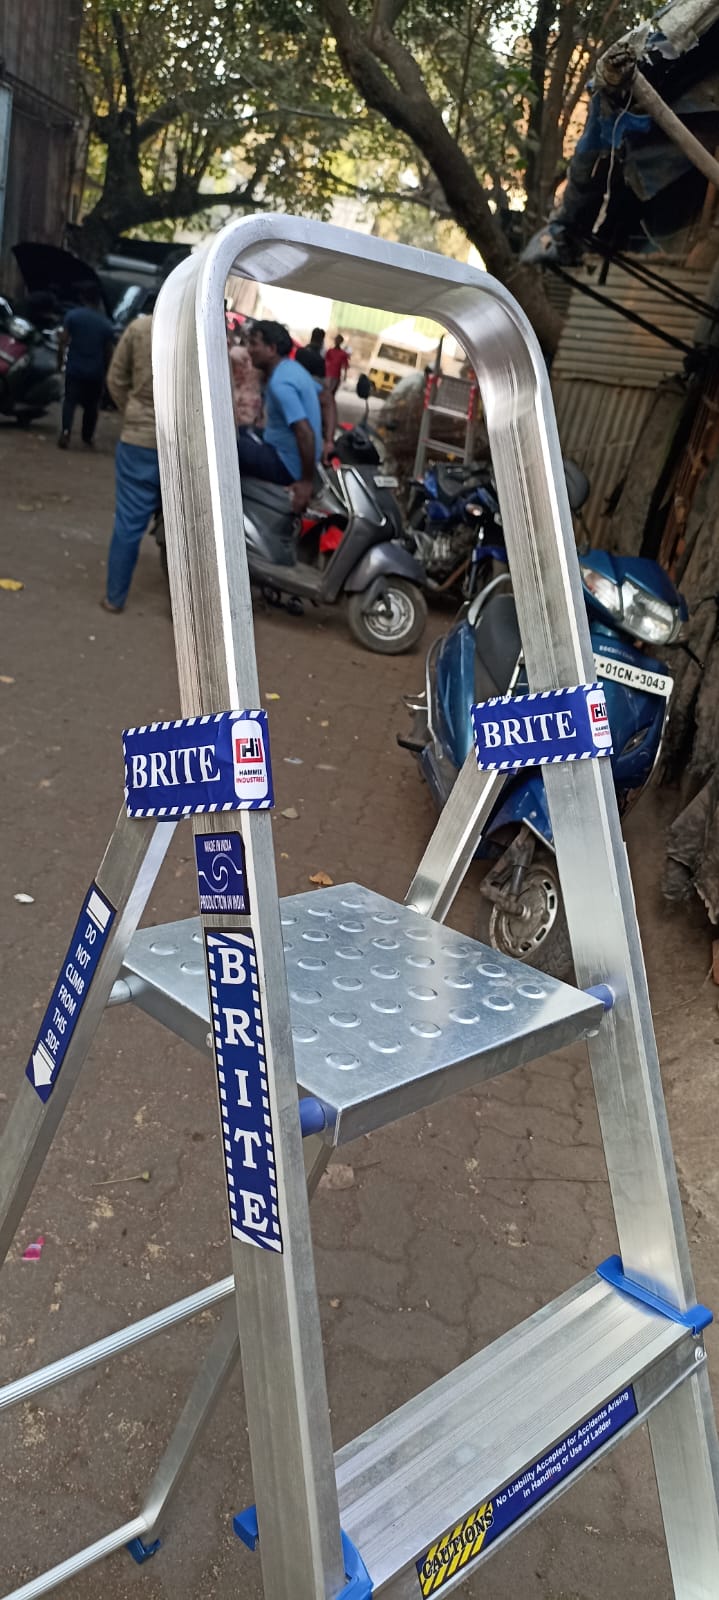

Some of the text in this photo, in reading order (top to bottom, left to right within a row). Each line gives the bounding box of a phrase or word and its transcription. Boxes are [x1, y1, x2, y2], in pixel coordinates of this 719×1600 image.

[481, 710, 577, 749] BRITE
[131, 744, 221, 789] BRITE
[203, 840, 216, 852] MADE
[221, 839, 233, 850] INDIA
[200, 895, 227, 910] PRODUCTION
[233, 895, 245, 910] INDIA
[85, 923, 97, 945] DO
[75, 943, 92, 969] NOT
[65, 963, 85, 995] CLIMB
[58, 984, 77, 1017] FROM
[52, 1007, 67, 1035] THIS
[45, 1029, 60, 1055] SIDE
[218, 947, 270, 1233] BRITE
[495, 1391, 629, 1507] No Liability Accepted for Accidents Arising
[523, 1418, 611, 1498] in Handling or Use of Ladder
[422, 1510, 494, 1580] CAUTIONS
